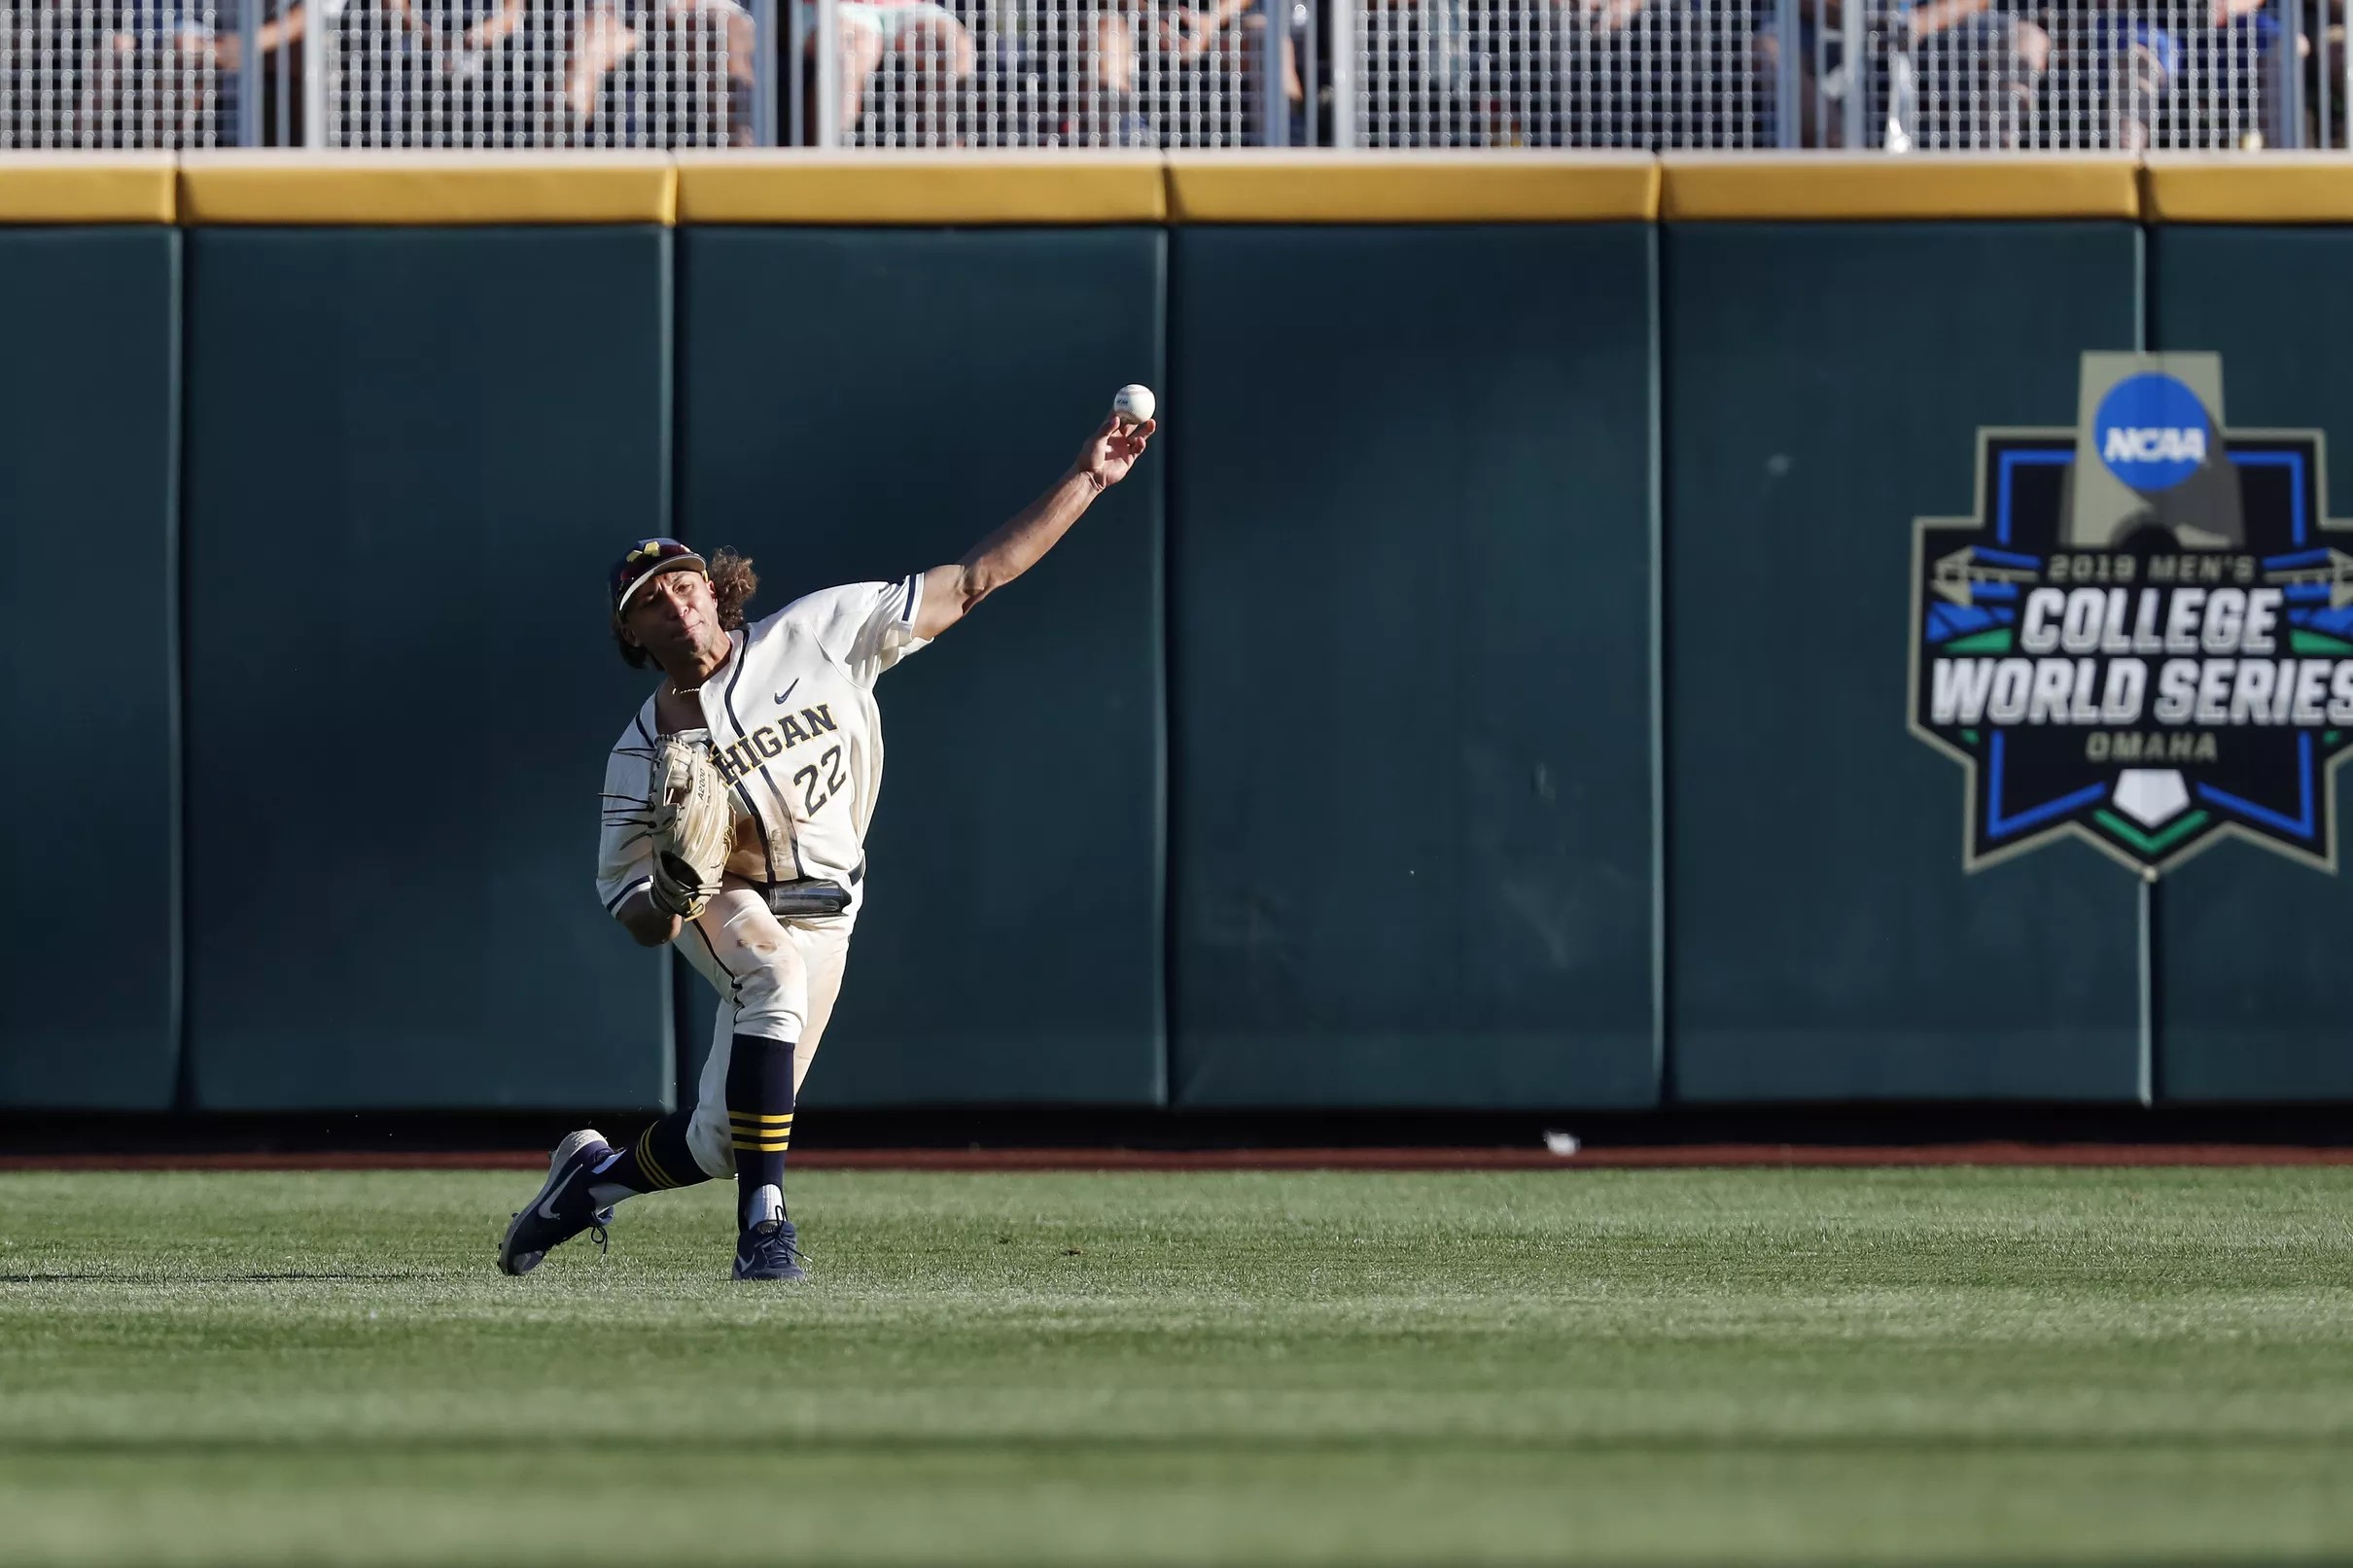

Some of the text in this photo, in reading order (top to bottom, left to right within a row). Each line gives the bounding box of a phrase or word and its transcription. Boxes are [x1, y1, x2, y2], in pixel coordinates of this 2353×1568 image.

[2104, 426, 2205, 462] NCAA
[2020, 587, 2284, 654] COLLEGE
[1931, 658, 2353, 725] WORLD SERIES
[708, 703, 839, 788] HIGAN
[2086, 733, 2217, 762] OMAHA
[793, 744, 847, 818] 22
